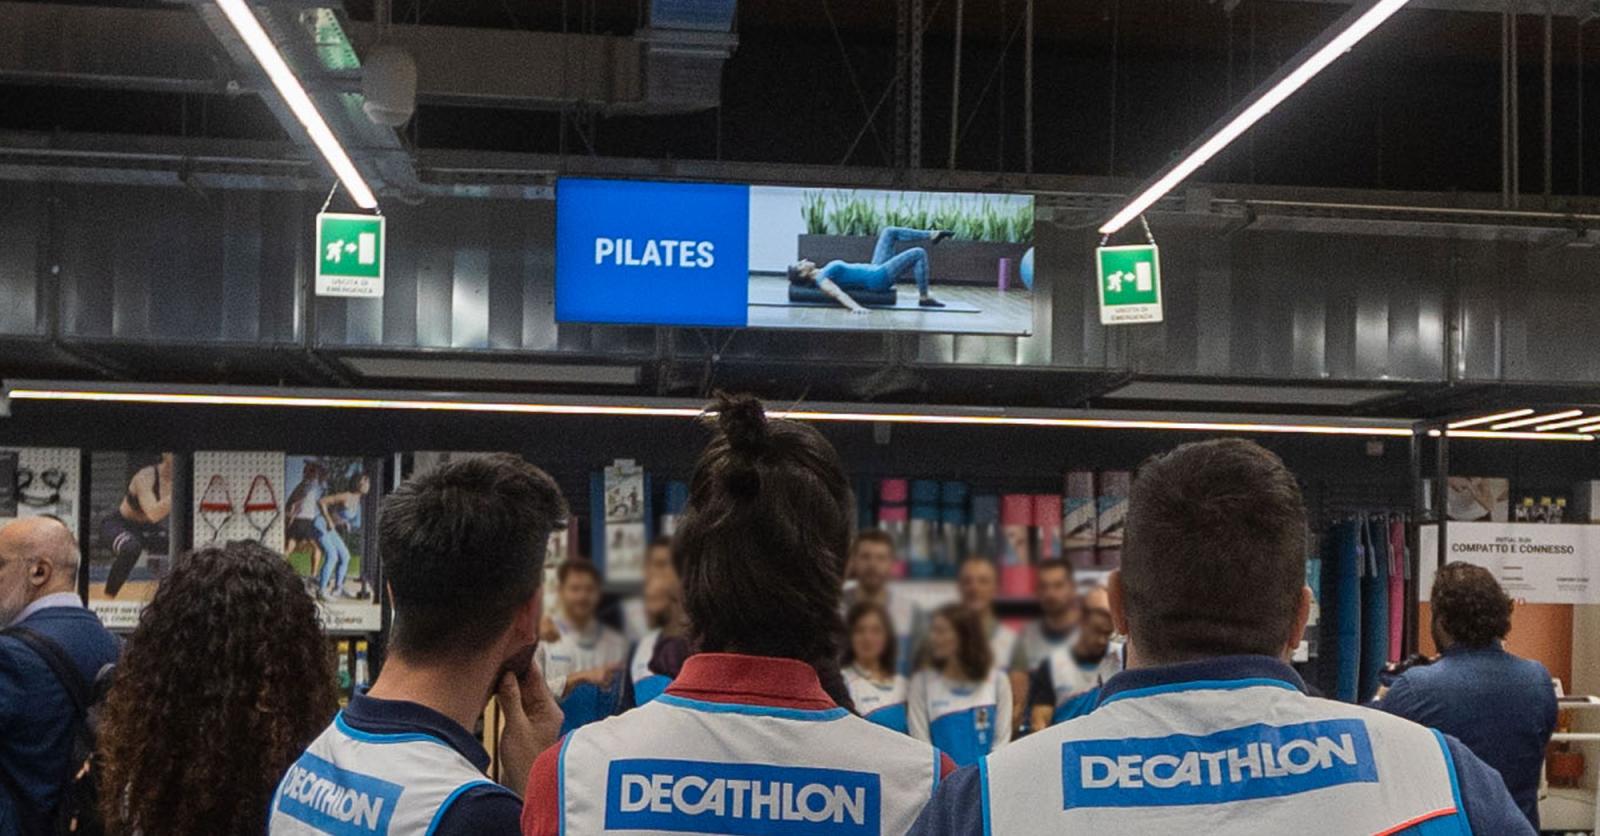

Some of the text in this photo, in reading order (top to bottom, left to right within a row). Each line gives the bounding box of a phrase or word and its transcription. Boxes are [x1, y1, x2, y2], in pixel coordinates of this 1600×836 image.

[595, 238, 715, 268] PILATES
[1451, 543, 1575, 555] COMPATTO E CONNESSO
[1080, 733, 1357, 789] DECATHLON
[283, 766, 384, 831] DECATHLON
[620, 774, 866, 825] DECATHLON
